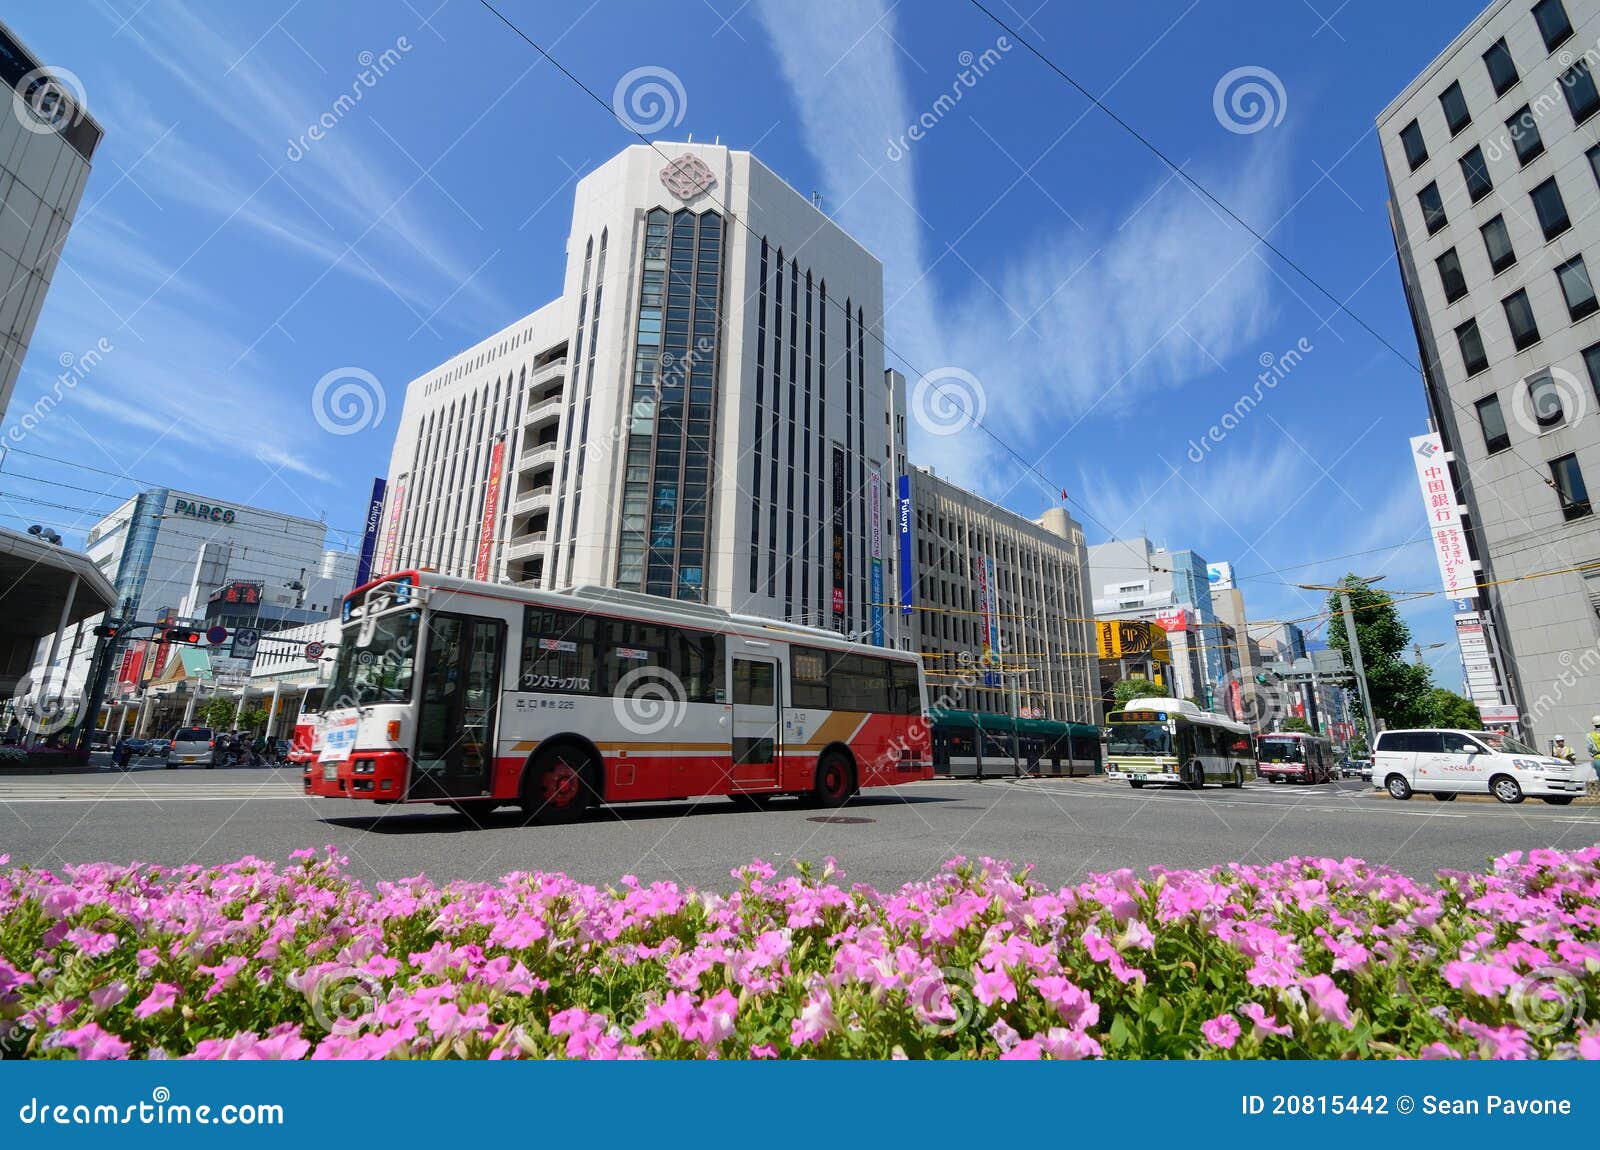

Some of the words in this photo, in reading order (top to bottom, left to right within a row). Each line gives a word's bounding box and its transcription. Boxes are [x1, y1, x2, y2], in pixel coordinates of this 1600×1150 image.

[1425, 466, 1451, 522] 中国銀行
[174, 499, 235, 524] PARCO
[367, 500, 382, 533] Fukuya
[900, 498, 910, 534] Fukuya
[1448, 528, 1464, 565] ちゅうぎん
[1437, 530, 1458, 597] 住宅ローンセンター
[524, 674, 590, 690] ワンステップバス
[558, 700, 575, 710] 225
[1449, 765, 1475, 773] さくらんぼ
